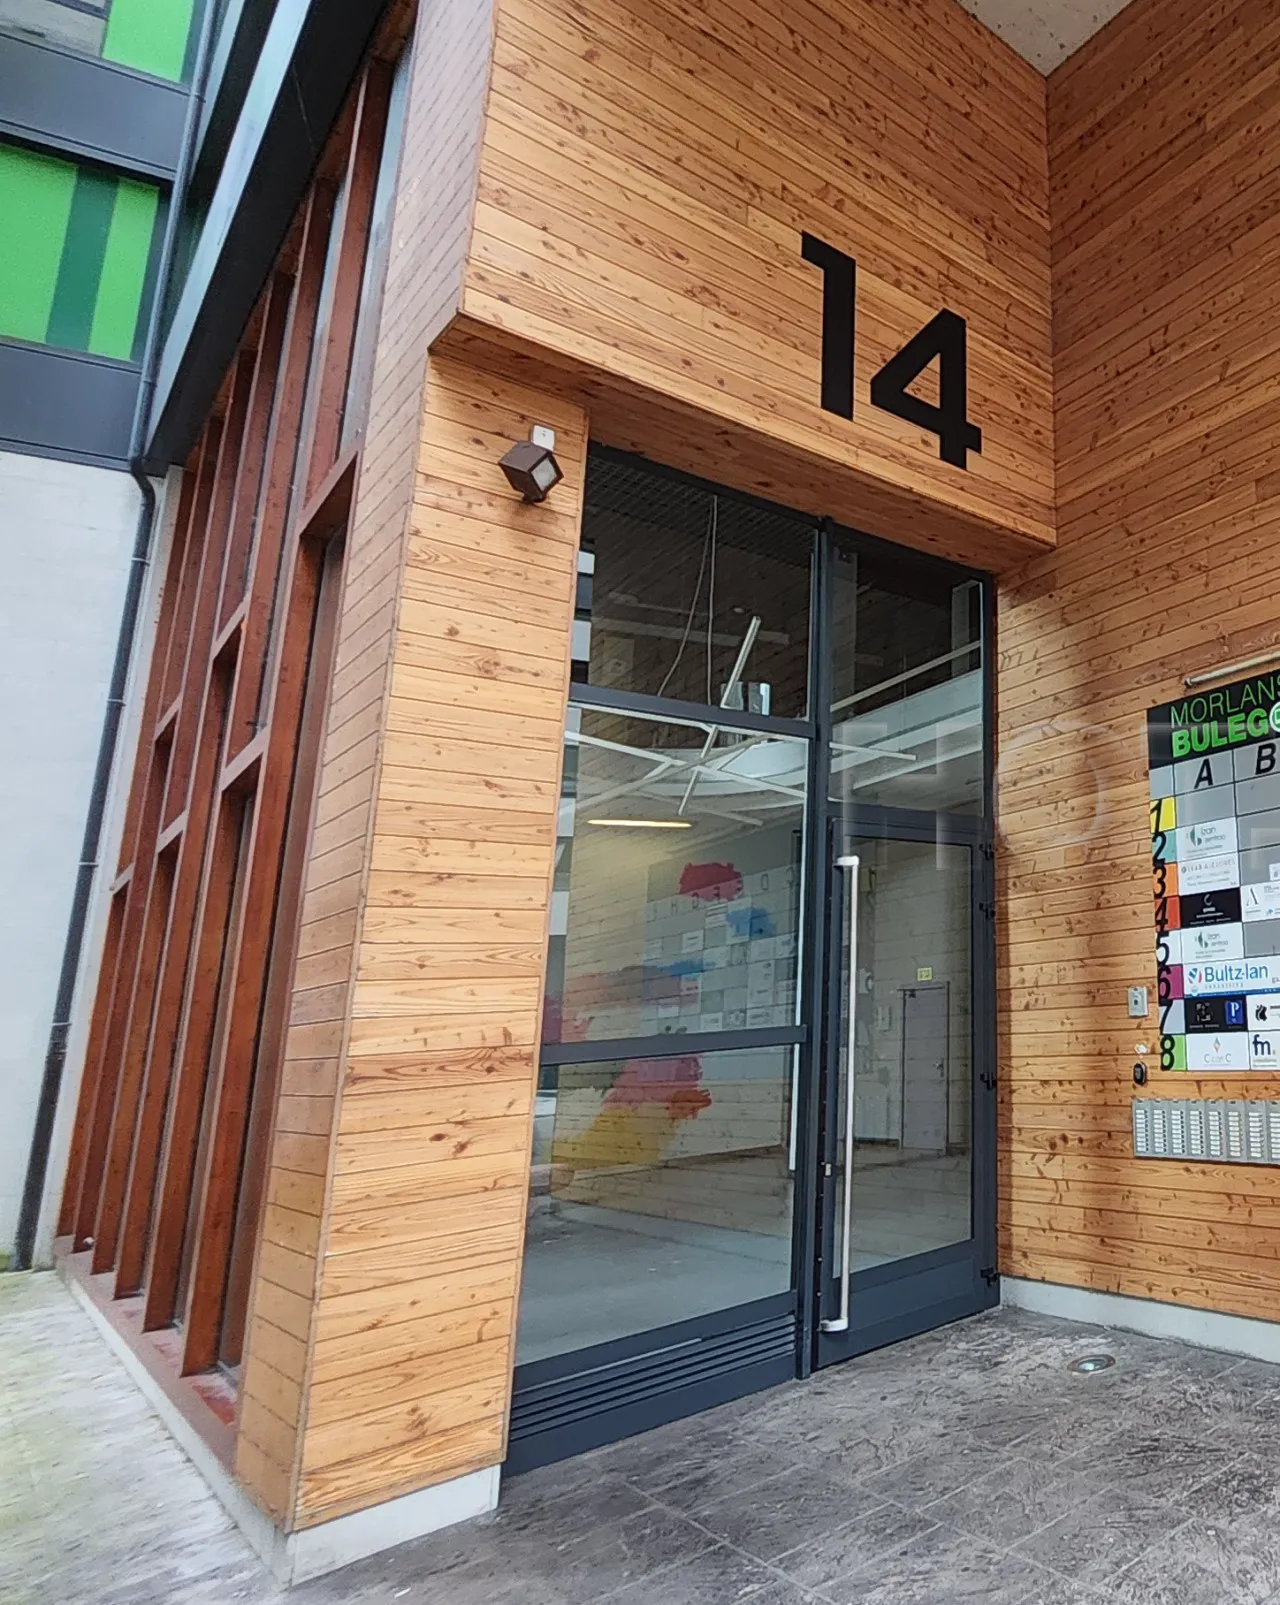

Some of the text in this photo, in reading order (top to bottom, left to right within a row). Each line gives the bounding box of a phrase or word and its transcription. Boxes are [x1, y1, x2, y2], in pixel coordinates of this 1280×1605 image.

[800, 229, 982, 471] 14
[1194, 759, 1214, 789] A
[1255, 743, 1277, 774] B
[1150, 799, 1162, 832] 1
[1152, 832, 1167, 864] 2
[1153, 864, 1167, 898] 3
[1155, 897, 1169, 928] 4
[1156, 929, 1170, 964] 5
[1158, 964, 1171, 1000] 6
[1159, 999, 1174, 1035] 7
[1160, 1034, 1176, 1071] 8
